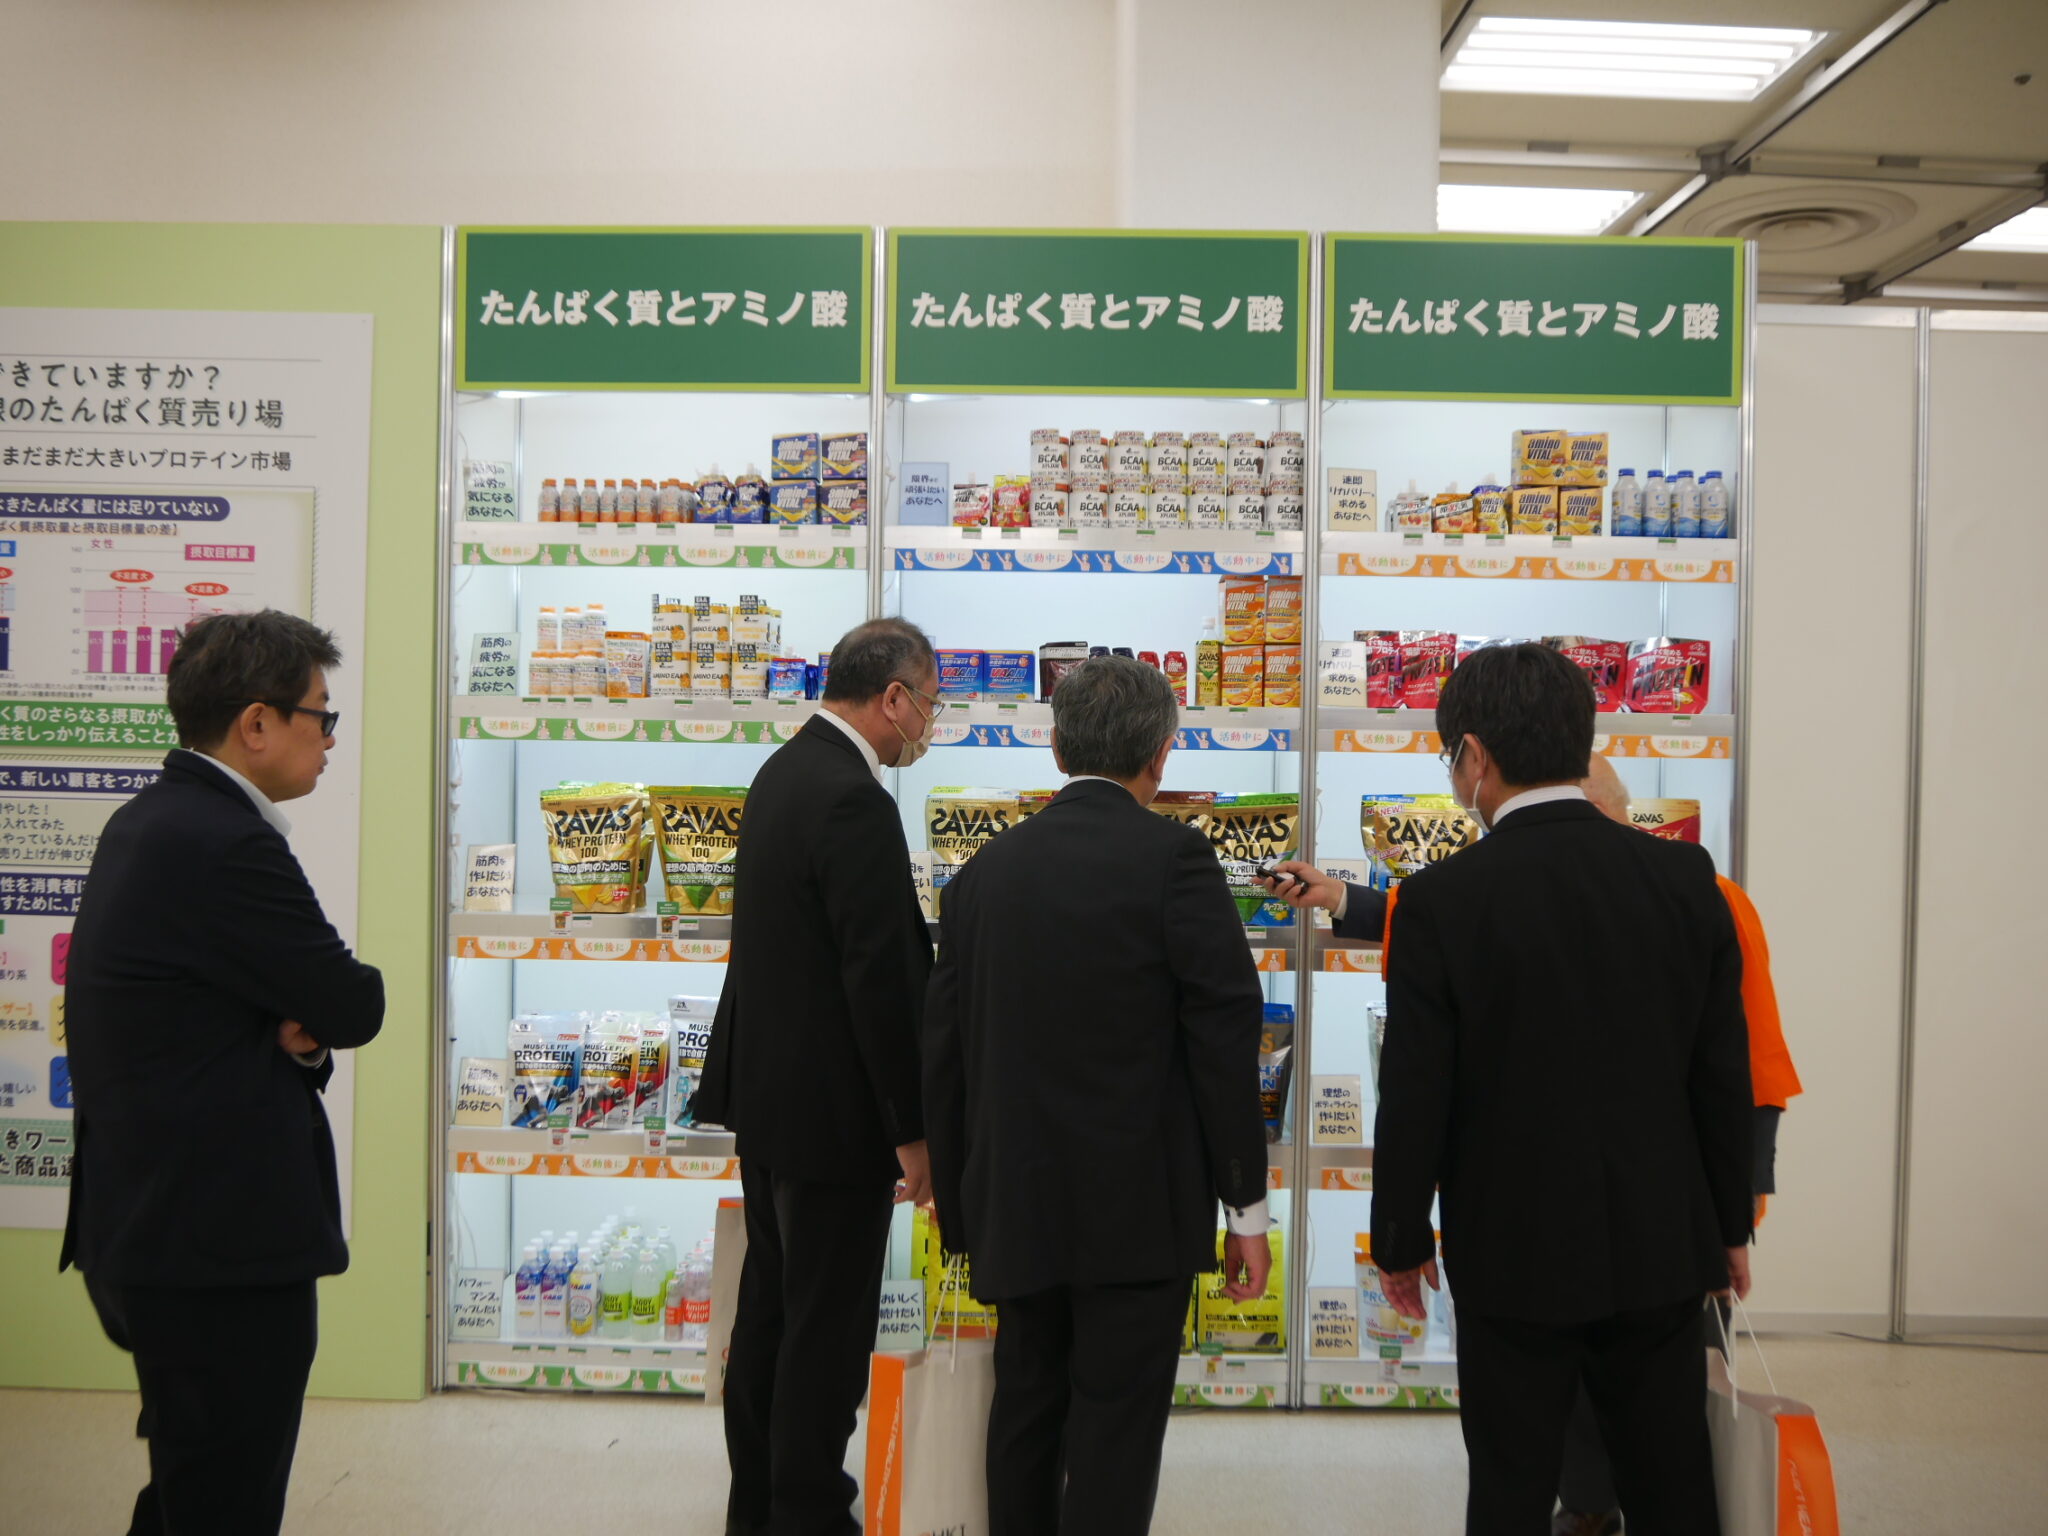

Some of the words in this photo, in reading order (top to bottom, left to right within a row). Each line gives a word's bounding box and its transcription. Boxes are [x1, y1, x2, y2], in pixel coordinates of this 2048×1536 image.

[480, 290, 848, 328] たんぱく質とアミノ酸
[910, 292, 1284, 333] たんぱく質とアミノ酸
[1348, 297, 1720, 341] たんぱく質とアミノ酸
[1528, 437, 1560, 450] amino
[1571, 438, 1603, 451] amino
[2, 446, 292, 472] まだまだ大きいプロテイン市場
[1038, 455, 1063, 464] BCAA
[1080, 455, 1105, 464] BCAA
[1527, 449, 1551, 460] VITAL
[1571, 450, 1593, 461] VITAL
[1120, 457, 1144, 465] BCAA
[1158, 457, 1182, 466] BCAA
[1193, 457, 1218, 466] BCAA
[1234, 458, 1259, 467] BCAA
[468, 490, 513, 503] 気になる
[906, 496, 944, 506] あなたへ
[1519, 492, 1551, 505] amino
[1567, 493, 1598, 506] amino
[1034, 502, 1058, 511] BCAA
[1080, 502, 1105, 511] BCAA
[1115, 503, 1139, 512] BCAA
[1156, 503, 1181, 512] BCAA
[1197, 504, 1222, 513] BCAA
[1338, 499, 1367, 510] 求める
[1518, 504, 1542, 515] VITAL
[468, 506, 514, 518] あなたへ
[1333, 511, 1371, 521] あなたへ
[1566, 505, 1588, 517] VITAL
[91, 538, 114, 549] 女性
[924, 553, 966, 563] 活動中に
[1023, 554, 1066, 564] 活動中に
[1123, 555, 1165, 564] 活動中に
[1222, 555, 1265, 565] 活動中に
[1367, 557, 1410, 568] 活動後に
[1466, 558, 1509, 569] 活動後に
[1565, 560, 1606, 572] 活動後に
[1663, 562, 1705, 573] 活動後に
[1227, 590, 1254, 602] amino
[1269, 589, 1297, 600] amino
[1226, 600, 1247, 611] VITAL
[1268, 599, 1290, 609] VITAL
[481, 637, 512, 648] 筋肉の
[479, 652, 511, 663] 疲労が
[1224, 653, 1251, 665] amino
[1267, 654, 1295, 665] amino
[472, 665, 515, 677] 気になる
[941, 666, 978, 678] VAAM
[990, 667, 1027, 679] VAAM
[1223, 664, 1245, 674] VITAL
[1267, 664, 1289, 674] VITAL
[1328, 673, 1357, 684] 求める
[470, 681, 514, 693] あなたへ
[1323, 685, 1361, 696] あなたへ
[1219, 731, 1263, 742] 活動中に
[1362, 734, 1406, 745] 活動後に
[1658, 739, 1701, 750] 活動後に
[1379, 805, 1404, 817] NEW!
[0, 818, 64, 830] 入れてみた
[555, 805, 633, 837] SAVAS
[662, 804, 743, 837] SAVAS
[930, 808, 1010, 837] SAVAS
[1632, 813, 1664, 824] SAVAS
[1210, 813, 1290, 844] SAVAS
[1386, 817, 1468, 848] SAVAS
[557, 834, 582, 849] WHEY
[583, 832, 627, 848] PROTEIN
[665, 833, 692, 846] WHEY
[694, 835, 739, 849] PROTEIN
[932, 836, 959, 848] WHEY
[580, 847, 599, 859] 100
[690, 847, 710, 859] 100
[1220, 845, 1278, 864] AQUA
[476, 855, 506, 867] 筋肉を
[469, 870, 513, 882] 作りたい
[467, 886, 512, 898] あなたへ
[485, 940, 528, 951] 活動後に
[583, 941, 624, 953] 活動後に
[680, 943, 723, 954] 活動後に
[514, 1050, 575, 1062] PROTEIN
[1322, 1088, 1351, 1098] 理想の
[457, 1099, 503, 1112] あなたへ
[1319, 1111, 1356, 1121] 作りたい
[1318, 1124, 1357, 1135] あなたへ
[485, 1156, 527, 1167] 活動後に
[581, 1158, 623, 1170] 活動後に
[678, 1159, 721, 1171] 活動後に
[880, 1292, 920, 1305] おいしく
[1319, 1300, 1347, 1311] 理想の
[879, 1307, 922, 1321] 続けたい
[457, 1317, 496, 1328] あなたへ
[879, 1322, 922, 1335] あなたへ
[1316, 1324, 1352, 1335] 作りたい
[1314, 1337, 1353, 1349] あなたへ
